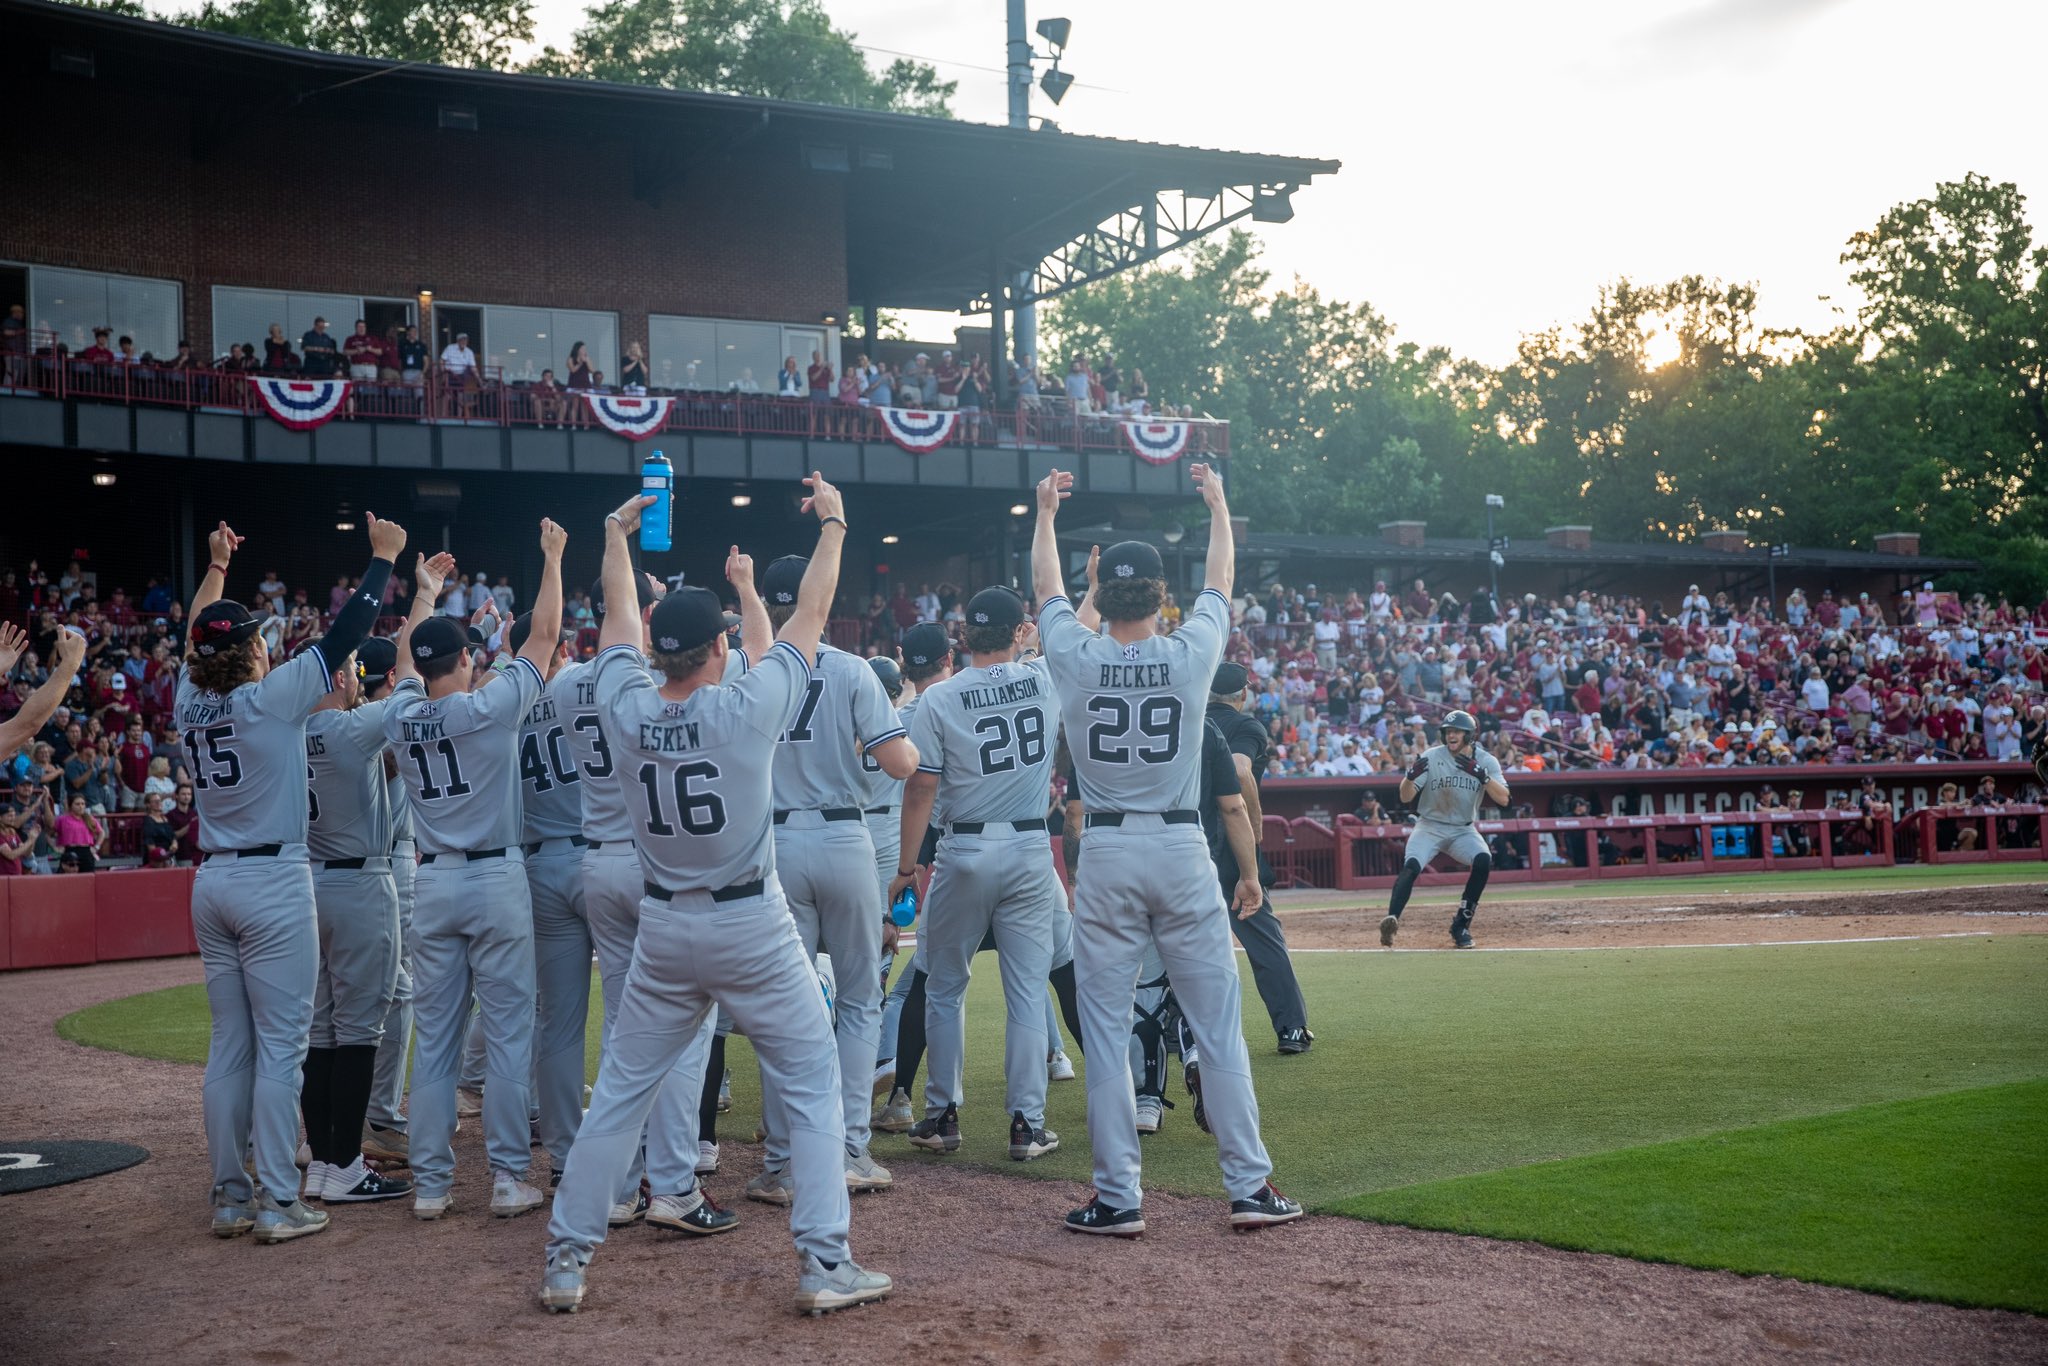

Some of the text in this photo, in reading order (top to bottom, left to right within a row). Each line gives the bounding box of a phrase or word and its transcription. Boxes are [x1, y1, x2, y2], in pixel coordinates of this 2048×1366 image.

[1099, 663, 1171, 688] BECKER
[1123, 645, 1139, 660] SEC
[776, 678, 826, 742] 7
[960, 677, 1040, 710] WILLIAMSON
[184, 723, 243, 790] 15
[520, 725, 580, 794] 40
[639, 722, 700, 751] ESKEW
[973, 705, 1048, 777] 28
[1086, 694, 1183, 765] 29
[409, 738, 473, 801] 11
[638, 759, 729, 837] 16
